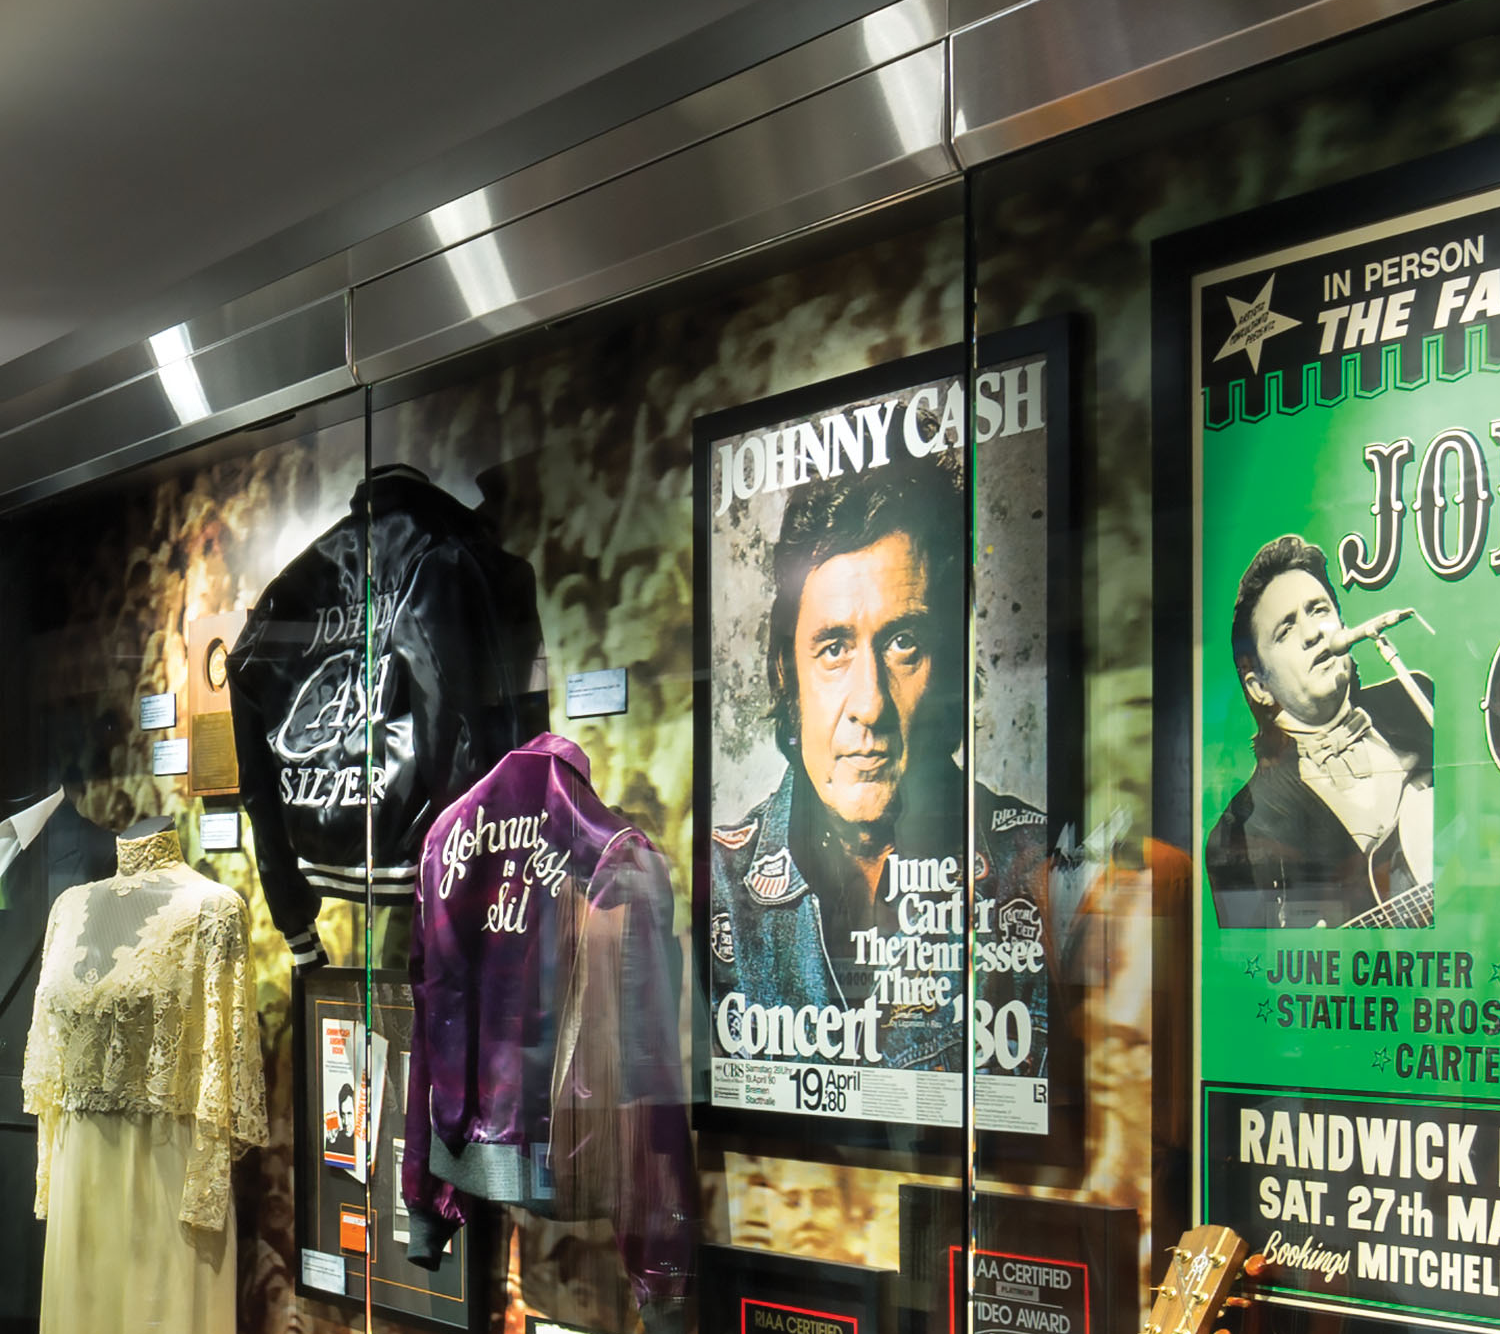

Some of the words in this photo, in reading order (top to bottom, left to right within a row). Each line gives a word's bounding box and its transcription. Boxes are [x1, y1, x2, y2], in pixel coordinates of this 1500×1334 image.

[1323, 273, 1351, 301] IN
[1363, 234, 1486, 295] PERSON
[1316, 290, 1411, 356] THE
[714, 398, 899, 518] JOHNNY
[902, 359, 1047, 459] CASH
[885, 853, 958, 903] June
[851, 926, 902, 968] The
[873, 967, 952, 1006] Three
[1266, 951, 1341, 988] JUNE
[1351, 950, 1475, 990] CARTER
[717, 991, 882, 1063] Concert
[1276, 995, 1400, 1034] STATLER
[723, 1063, 745, 1078] CBS
[745, 1085, 770, 1094] Bremen
[825, 1069, 861, 1092] April
[1238, 1107, 1478, 1186] RANDWICK
[1257, 1180, 1336, 1228] SAT.
[1346, 1190, 1435, 1239] 27th
[1002, 1262, 1072, 1290] CERTIFIED
[1262, 1228, 1352, 1283] Bookings
[754, 1310, 784, 1332] RIAA
[1016, 1308, 1071, 1334] AWARD
